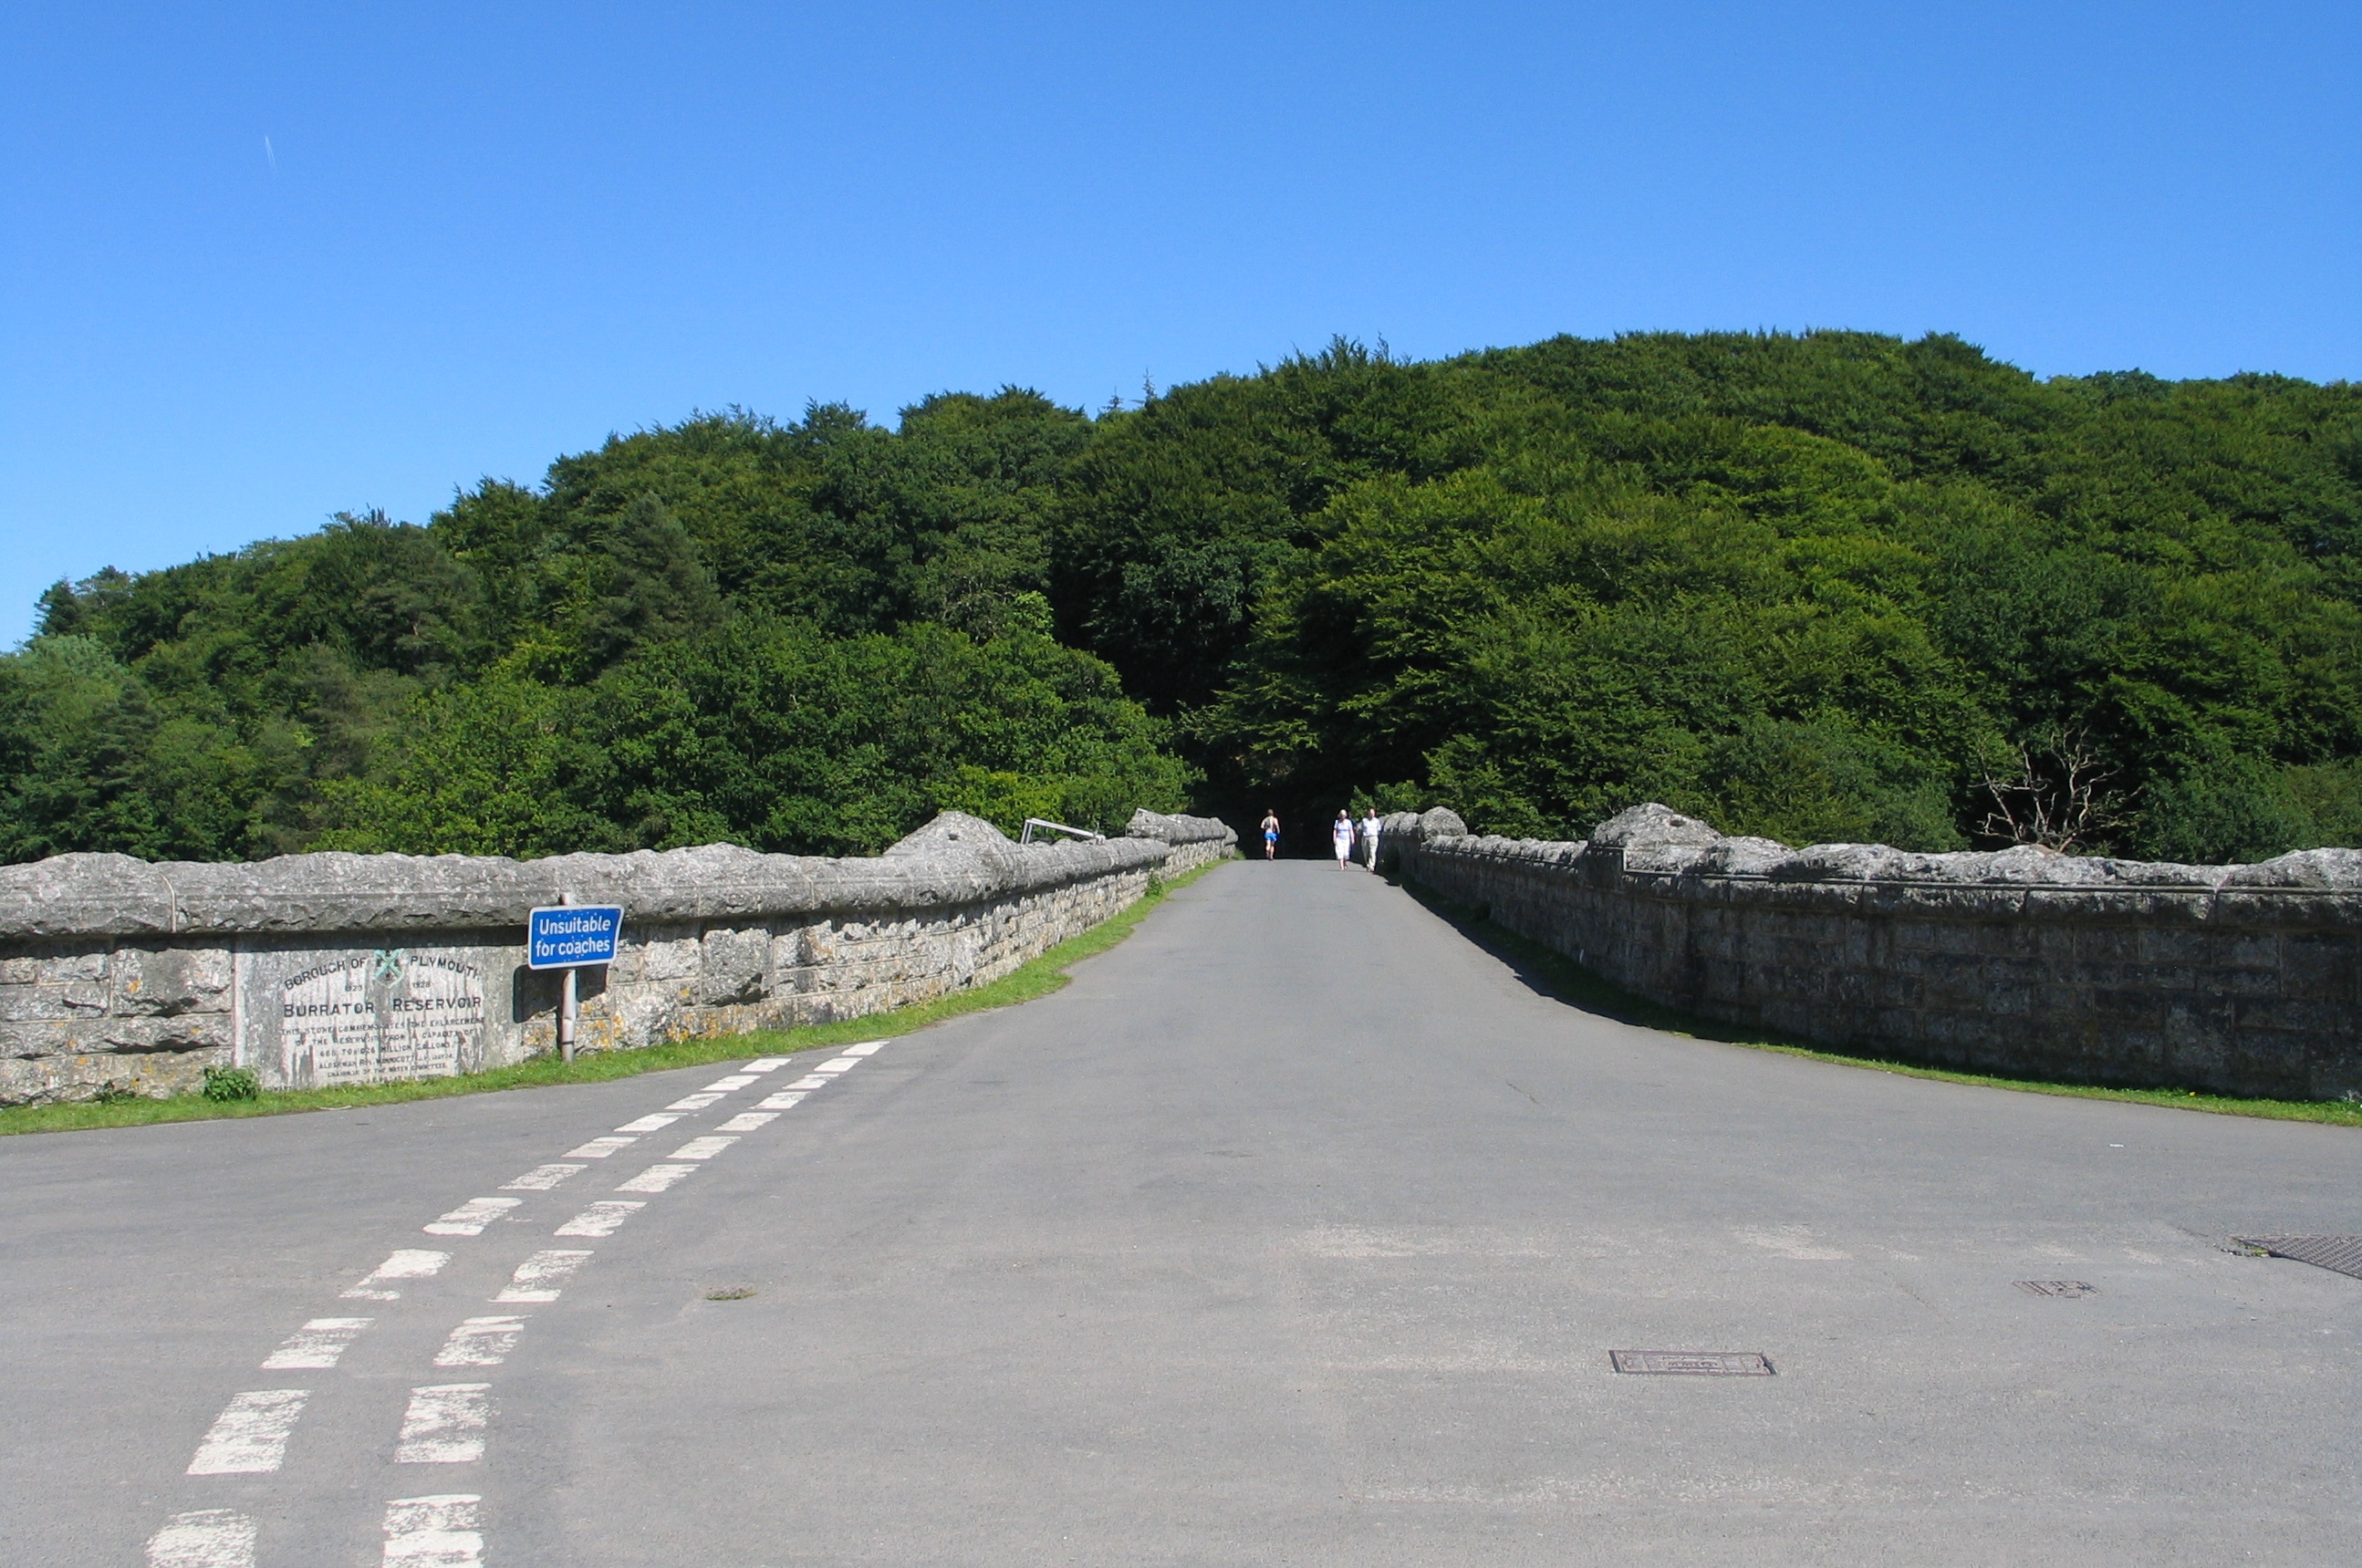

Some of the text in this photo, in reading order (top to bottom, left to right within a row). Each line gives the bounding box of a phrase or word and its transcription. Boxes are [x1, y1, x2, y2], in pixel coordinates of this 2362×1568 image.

[540, 916, 611, 936] Unsuitable
[536, 937, 610, 958] for coaches
[284, 955, 481, 992] BOROUGH OF PLYMOUTH
[284, 997, 482, 1018] BURRATOR RESERVOIR
